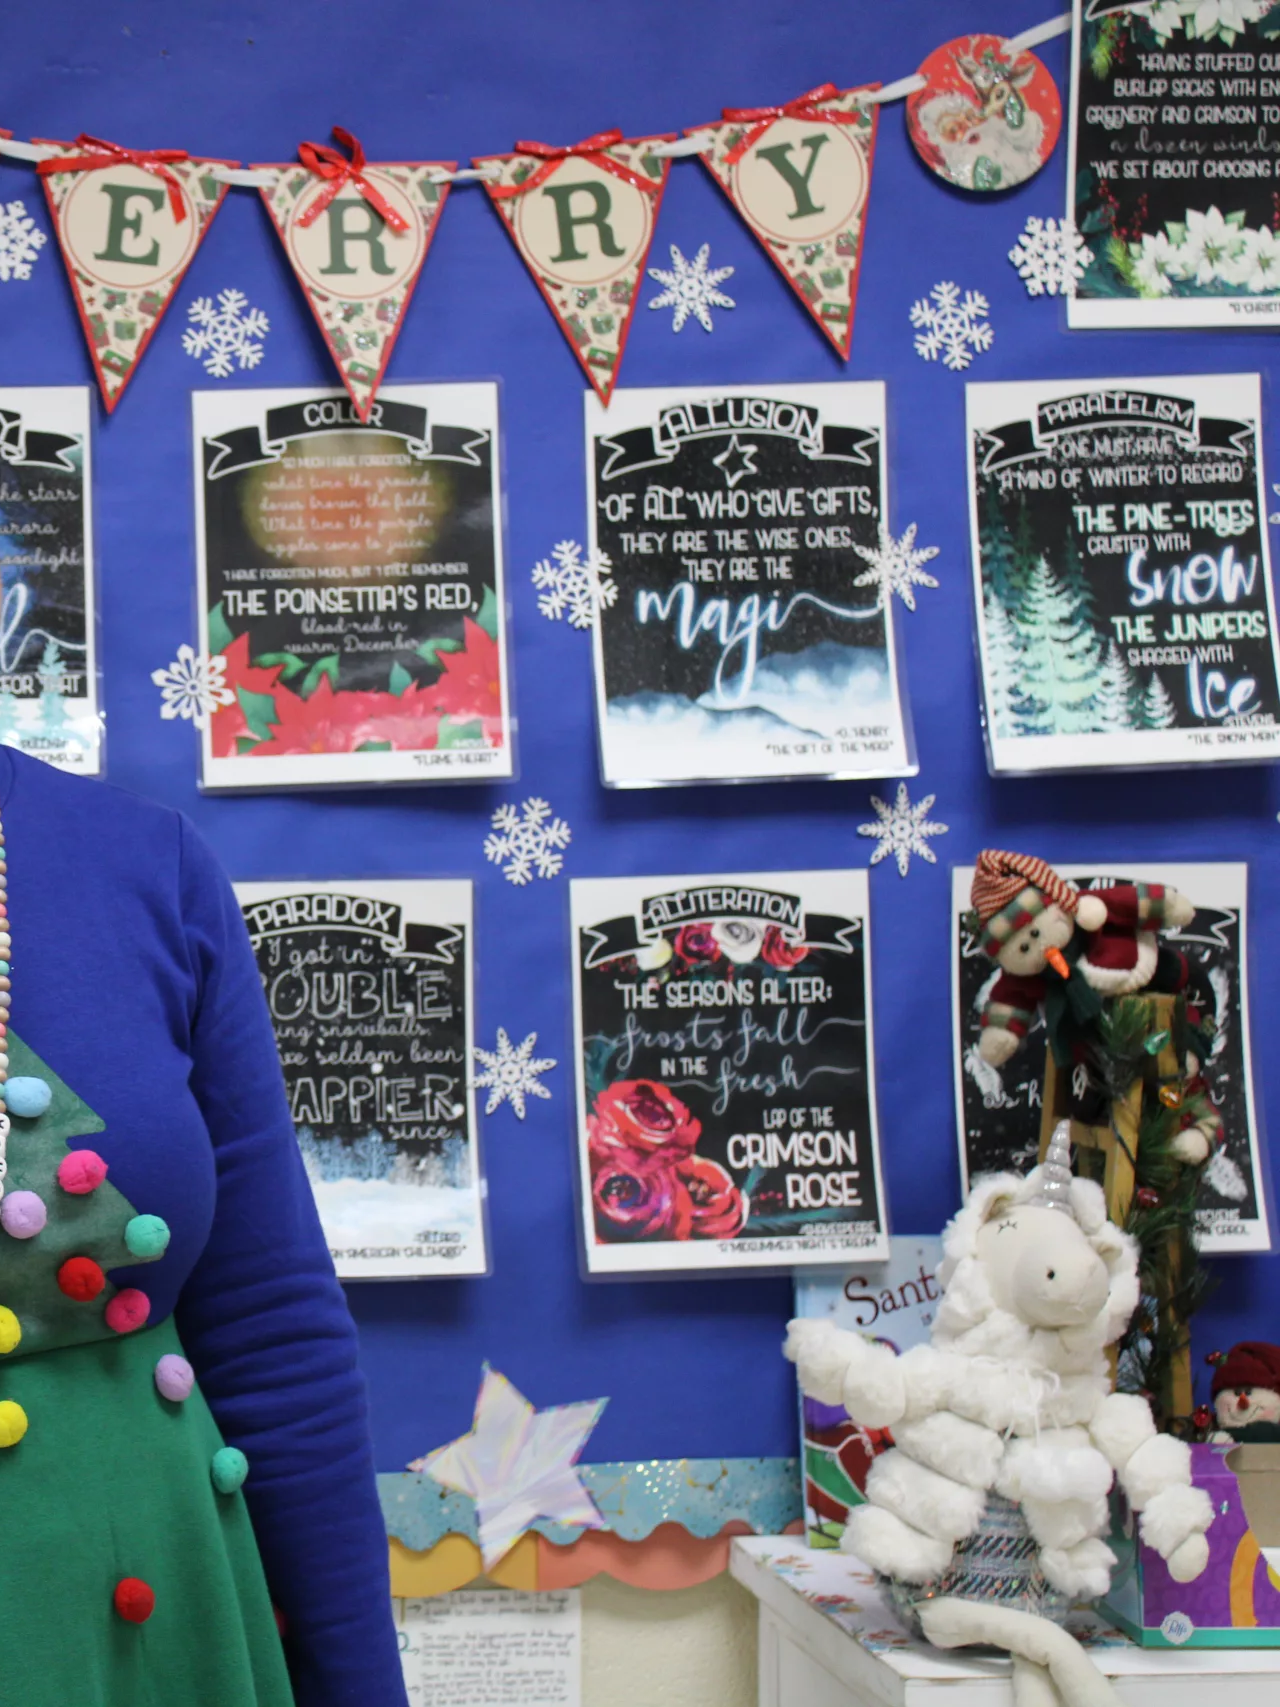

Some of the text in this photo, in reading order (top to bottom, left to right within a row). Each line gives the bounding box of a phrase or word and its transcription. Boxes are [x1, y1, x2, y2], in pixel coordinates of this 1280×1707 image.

[1195, 53, 1255, 72] STUFFED
[1114, 78, 1257, 97] BURLAP SACKS WITH
[1086, 105, 1257, 130] GREENERY AND CRIMSON
[1123, 160, 1271, 179] SET ABOUT CHOOSING
[661, 398, 818, 441] ALLUSION
[1040, 390, 1194, 427] PARALLELISM
[1095, 436, 1132, 457] MUST
[349, 471, 373, 487] the
[1015, 462, 1243, 489] MIND OF WINTER TO REGARD
[29, 482, 81, 502] stars
[644, 486, 687, 521] ALL
[687, 489, 750, 519] WHO
[751, 487, 805, 518] GIVE
[349, 510, 373, 529] the
[1072, 505, 1117, 533] THE
[620, 527, 799, 555] THEY ARE THE WISE
[1087, 533, 1191, 556] CRUSTED WITH
[682, 556, 793, 583] THEY ARE THE
[222, 583, 478, 616] THE POINSETTIA'S RED,
[301, 617, 408, 634] blood-red in
[1111, 611, 1267, 643] THE JUNIPERS
[285, 641, 340, 654] warm
[1128, 645, 1234, 667] SHAGGED WITH
[1187, 655, 1262, 719] Ice
[244, 895, 395, 932] PARADOX
[644, 888, 801, 926] ALLITERATION
[289, 937, 333, 977] got
[263, 968, 452, 1020] OUBLE
[615, 976, 833, 1009] THE SEASONS ALTER:
[317, 1040, 465, 1065] seldom been
[600, 1006, 842, 1071] frosts fall
[661, 1056, 708, 1075] IN THE
[287, 1075, 462, 1123] APPIER
[690, 1055, 830, 1115] fresh
[763, 1106, 835, 1129] LAP OF THE
[727, 1130, 858, 1169] CRIMSON
[785, 1171, 863, 1209] ROSE
[844, 1265, 940, 1327] Sant
